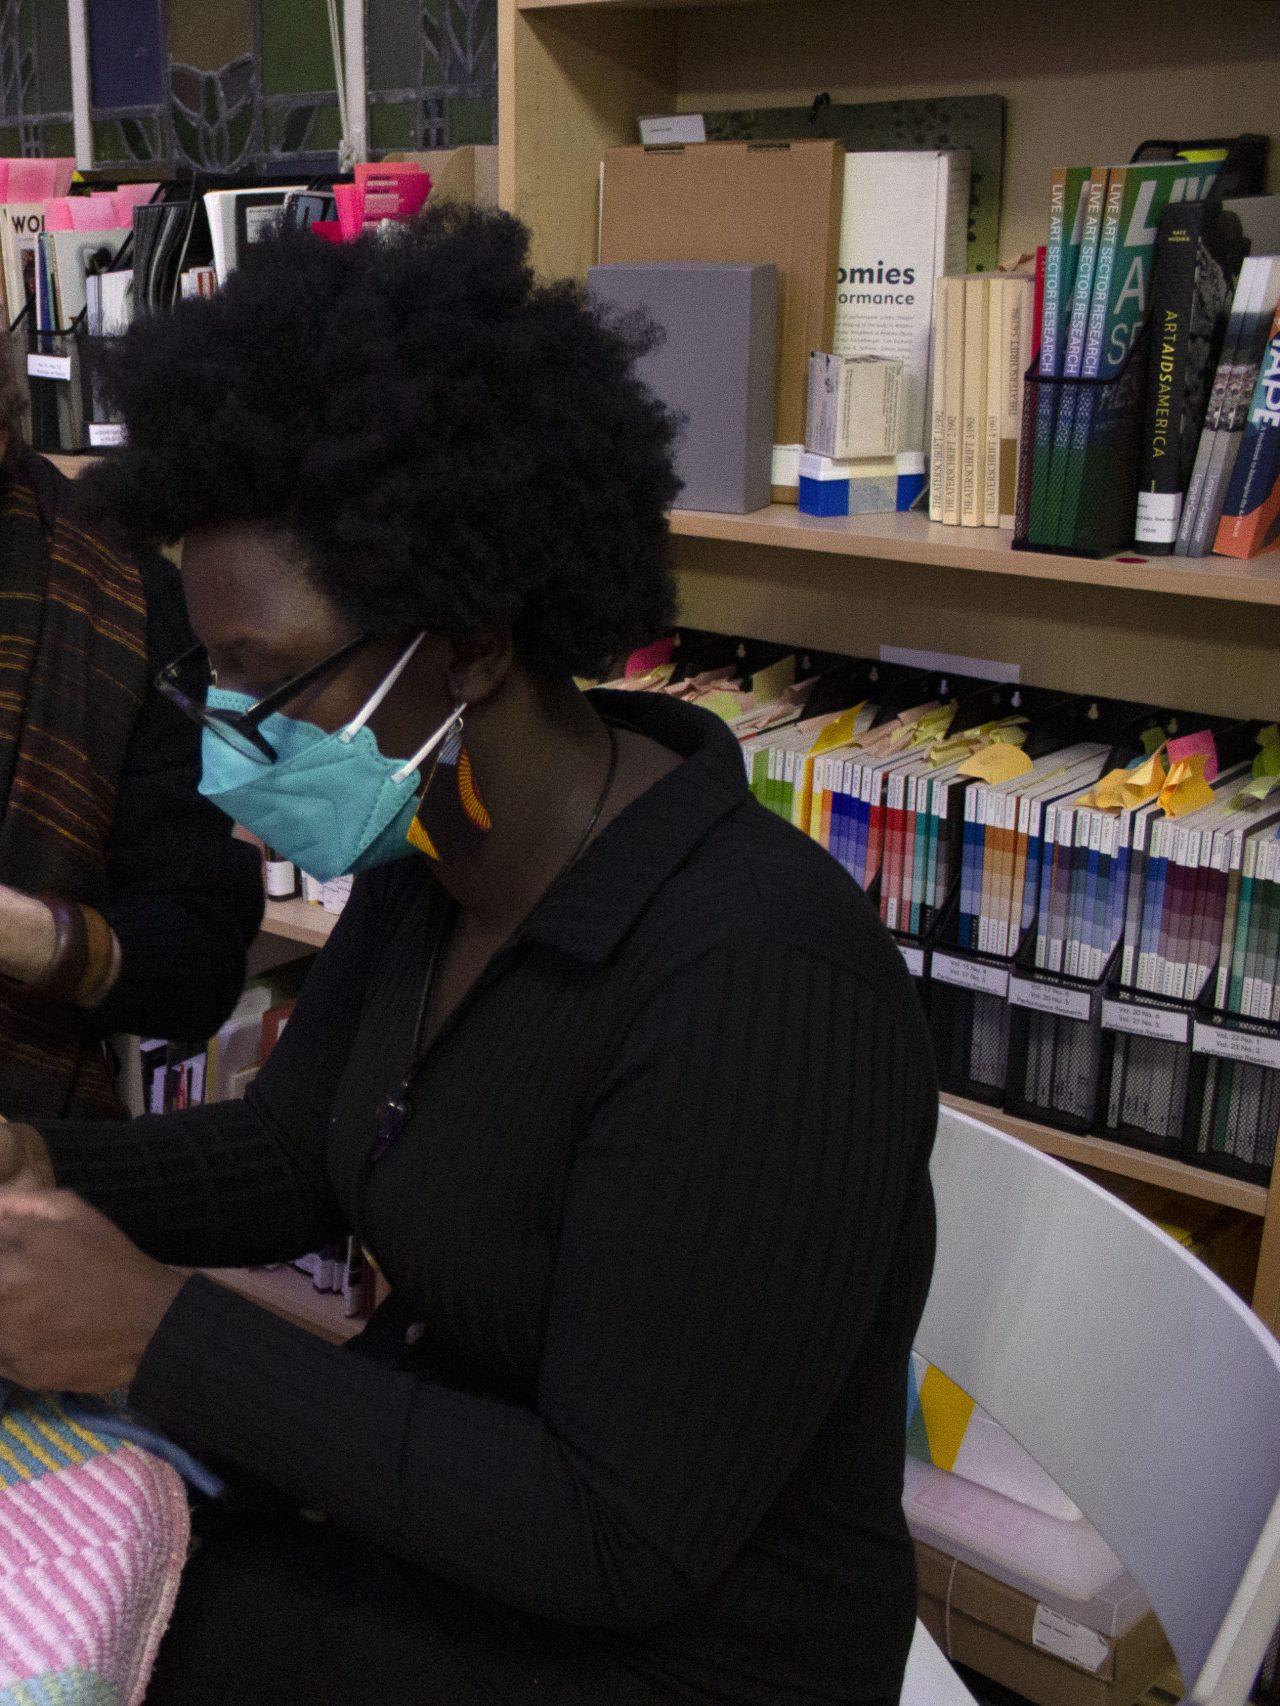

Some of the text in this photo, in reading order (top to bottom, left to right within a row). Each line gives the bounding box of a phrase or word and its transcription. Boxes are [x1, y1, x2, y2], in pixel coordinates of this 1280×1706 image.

[836, 260, 916, 285] omies
[838, 293, 915, 306] ormance
[1041, 184, 1064, 373] LIVE ART SECTOR RESEARCH
[1067, 183, 1102, 374] LIVE ART SECTOR RESEARCH
[1084, 184, 1122, 376] LIVE ART SECTOR RESEARCH
[945, 440, 956, 513] THEATERSCHRIFT
[962, 441, 974, 516] THEATERSCHRIFT
[986, 440, 997, 515] THEATERSCHRIFT
